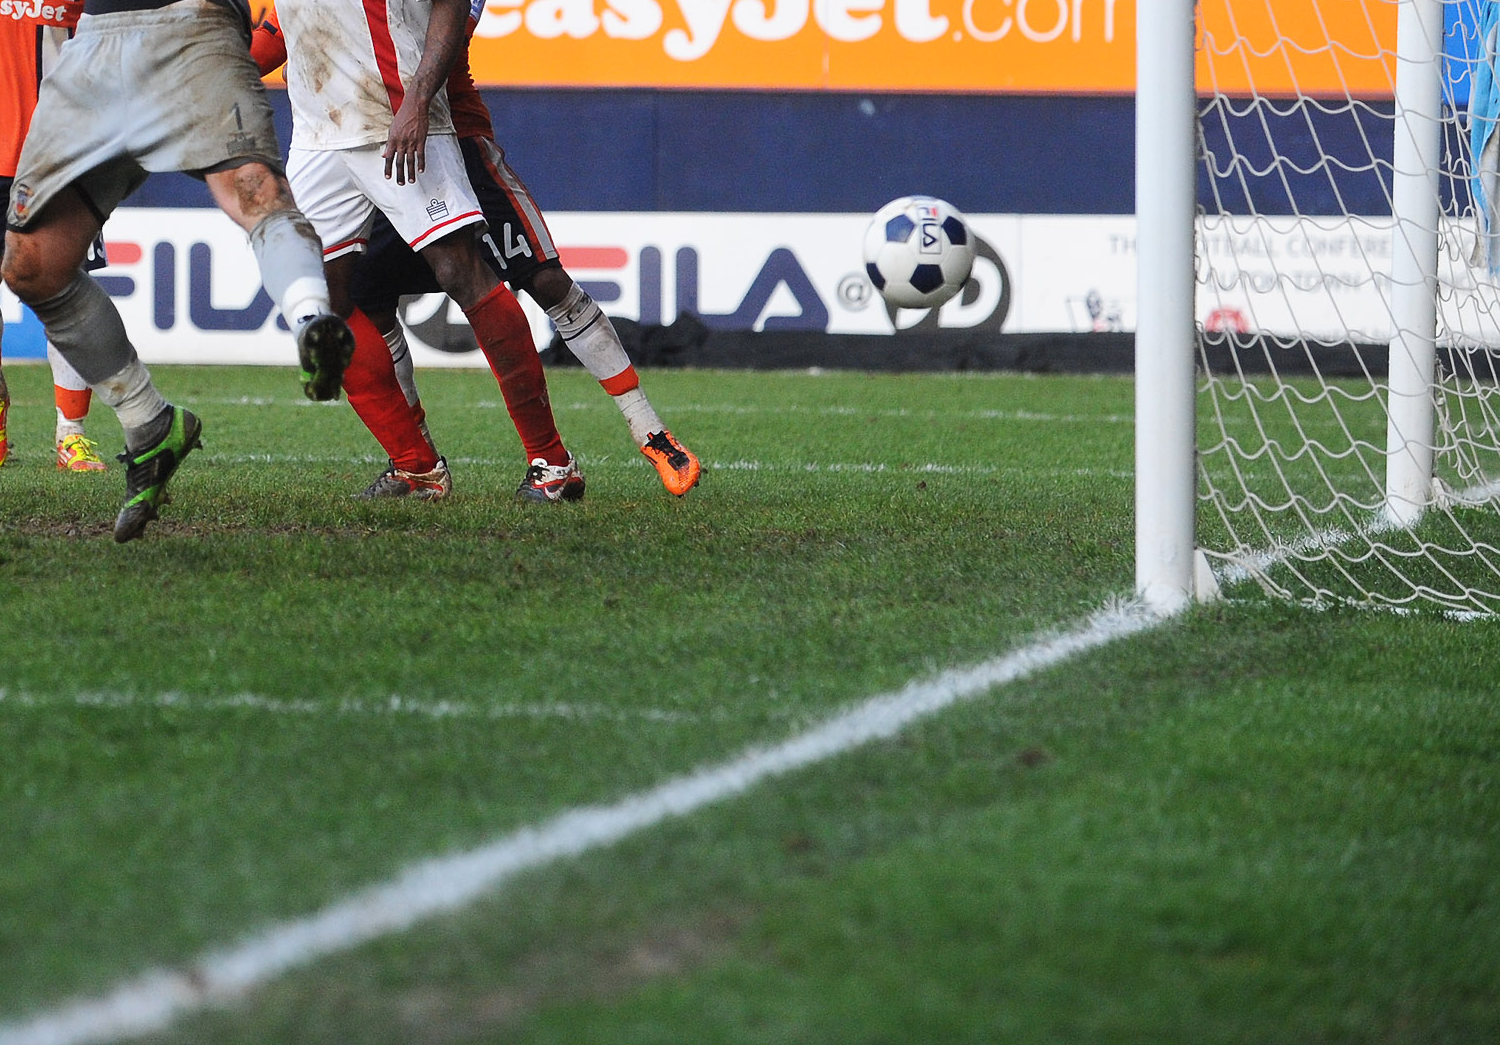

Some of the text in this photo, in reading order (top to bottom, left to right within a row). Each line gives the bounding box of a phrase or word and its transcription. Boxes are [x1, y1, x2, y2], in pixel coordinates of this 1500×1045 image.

[482, 222, 533, 270] 14
[919, 206, 939, 248] FILA
[1109, 236, 1137, 253] TH
